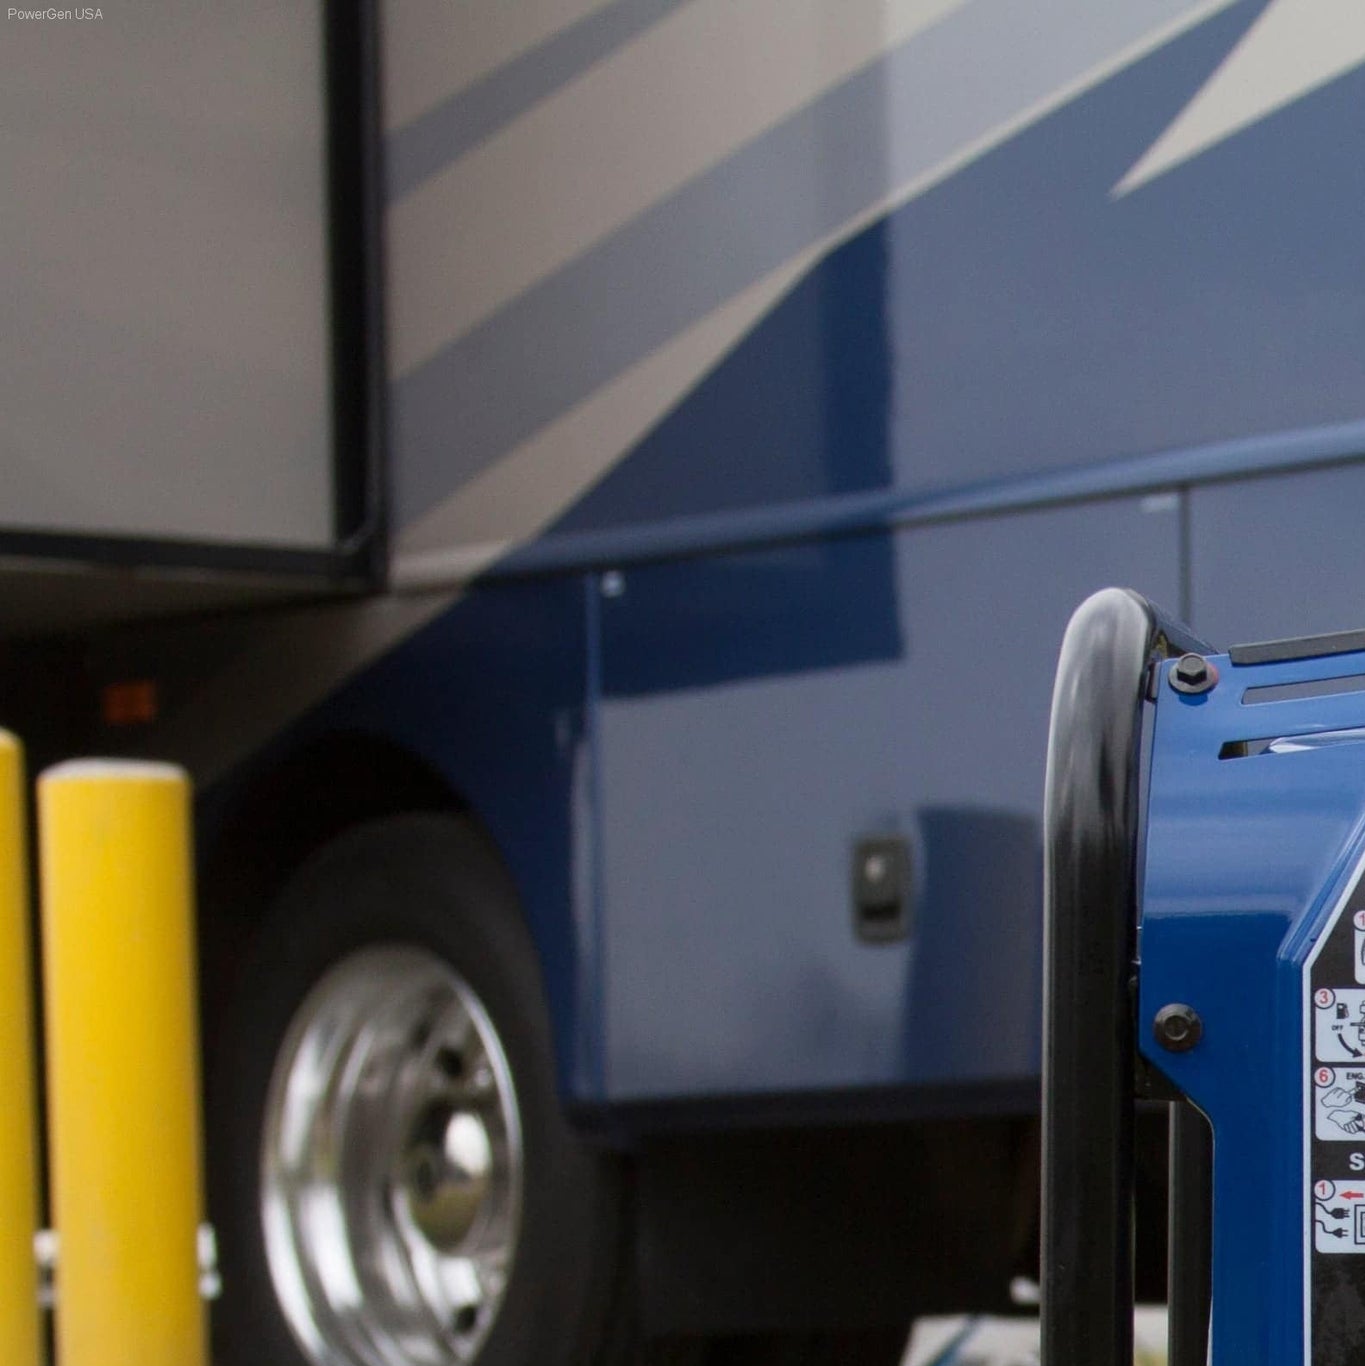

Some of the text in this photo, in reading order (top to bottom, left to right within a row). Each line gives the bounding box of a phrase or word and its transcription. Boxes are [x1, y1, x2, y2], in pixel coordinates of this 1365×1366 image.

[1359, 914, 1365, 926] 1
[1319, 991, 1328, 1004] 3
[1319, 1071, 1328, 1083] 6
[1319, 1184, 1326, 1196] 1
